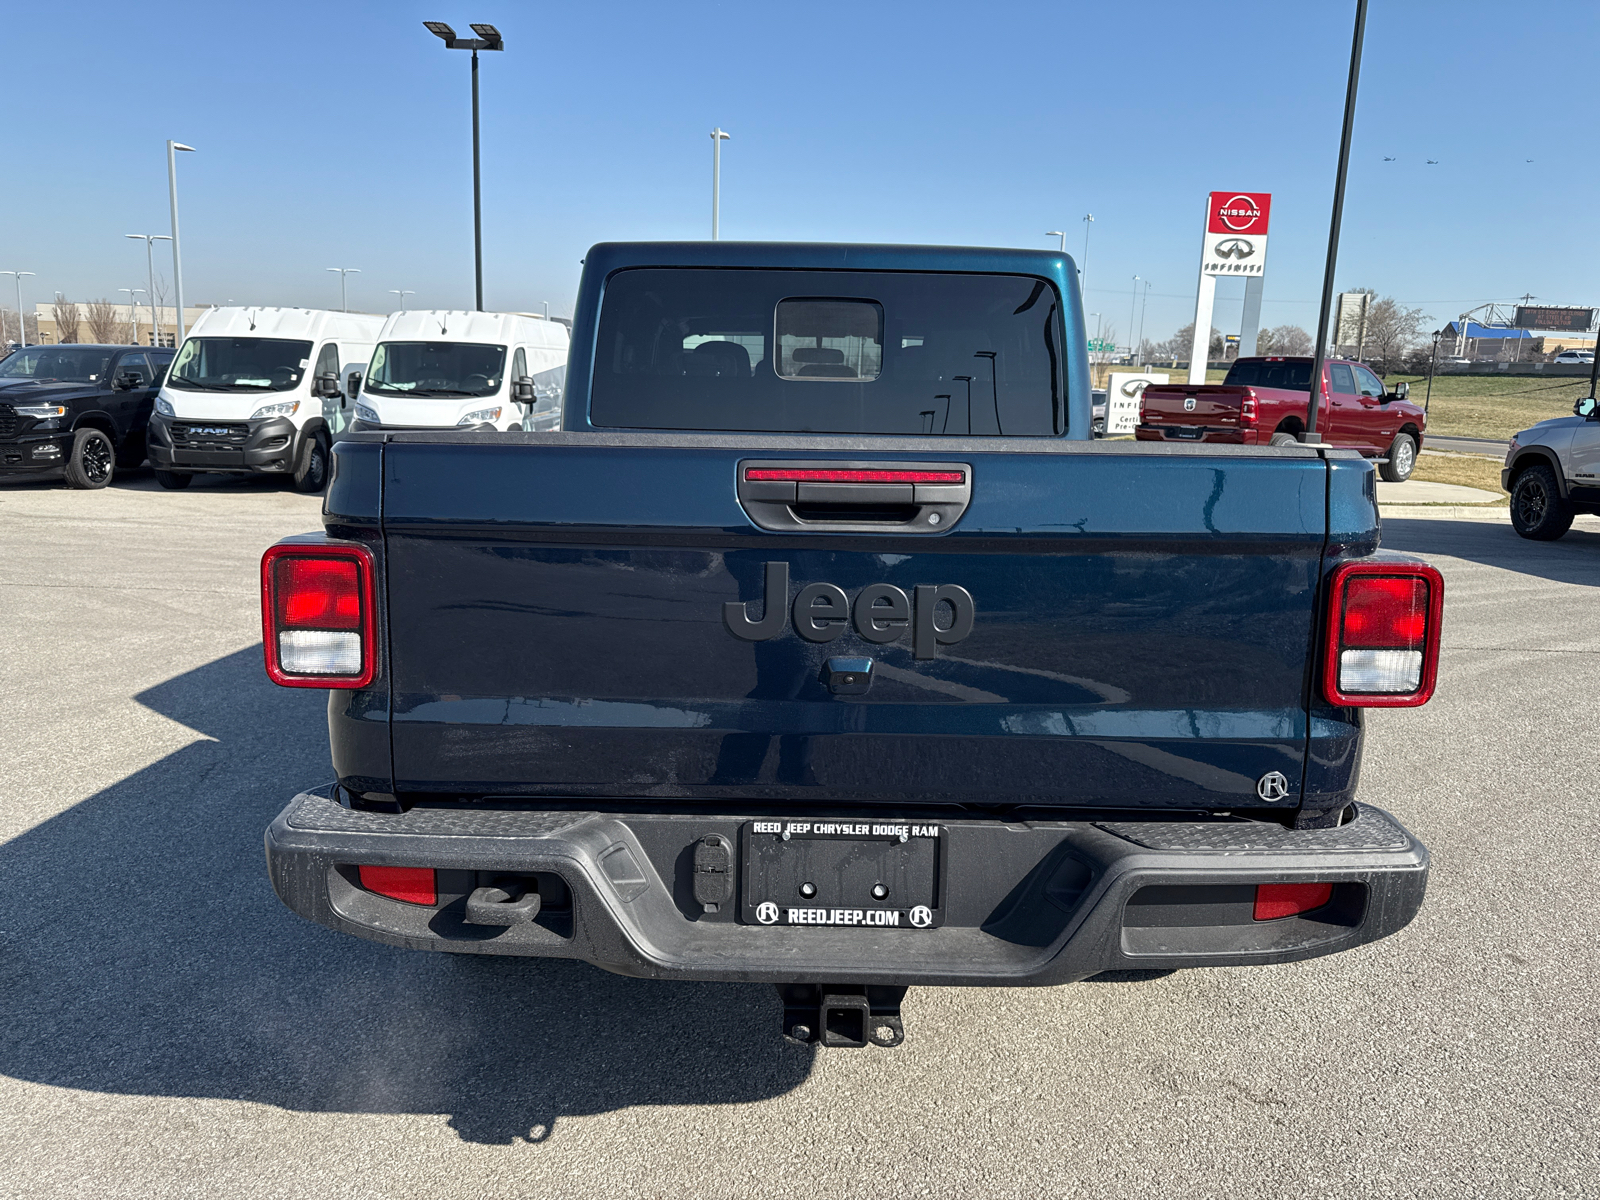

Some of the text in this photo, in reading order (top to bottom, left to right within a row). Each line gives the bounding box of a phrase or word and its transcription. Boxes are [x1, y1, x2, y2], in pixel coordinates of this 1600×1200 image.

[1204, 263, 1262, 273] INFINITI
[723, 561, 974, 660] Jeep
[754, 822, 938, 837] REED JEEP CHRYSLER DODGE RAM
[788, 908, 899, 925] REEDJEEP.COM
